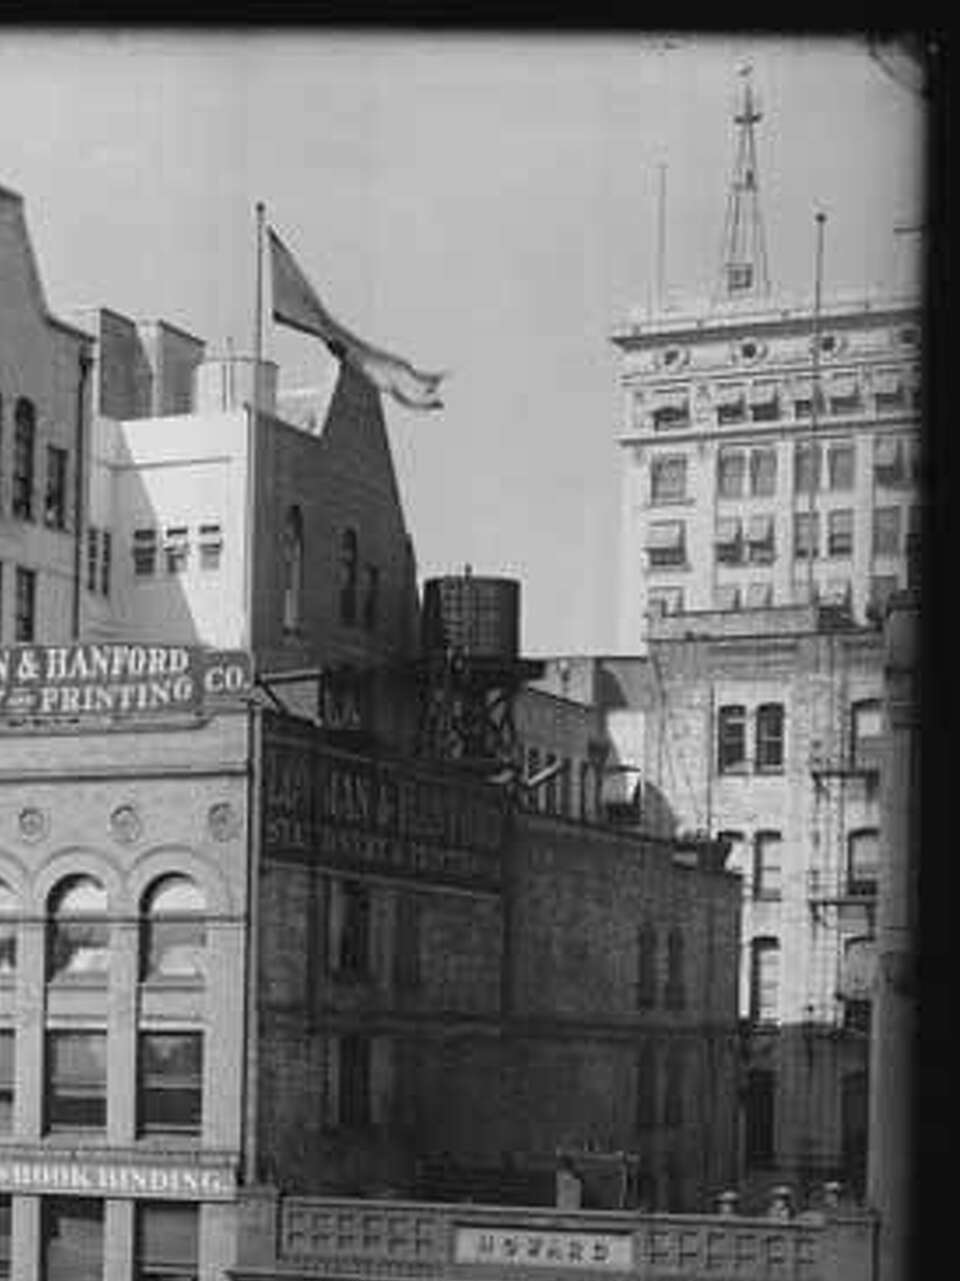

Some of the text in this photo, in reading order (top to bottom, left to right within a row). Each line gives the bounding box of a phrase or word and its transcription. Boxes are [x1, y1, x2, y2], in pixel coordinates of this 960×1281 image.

[17, 651, 37, 678] &
[46, 646, 190, 678] HANFORD
[41, 677, 192, 712] PRINTING
[13, 1163, 93, 1188] BOOK
